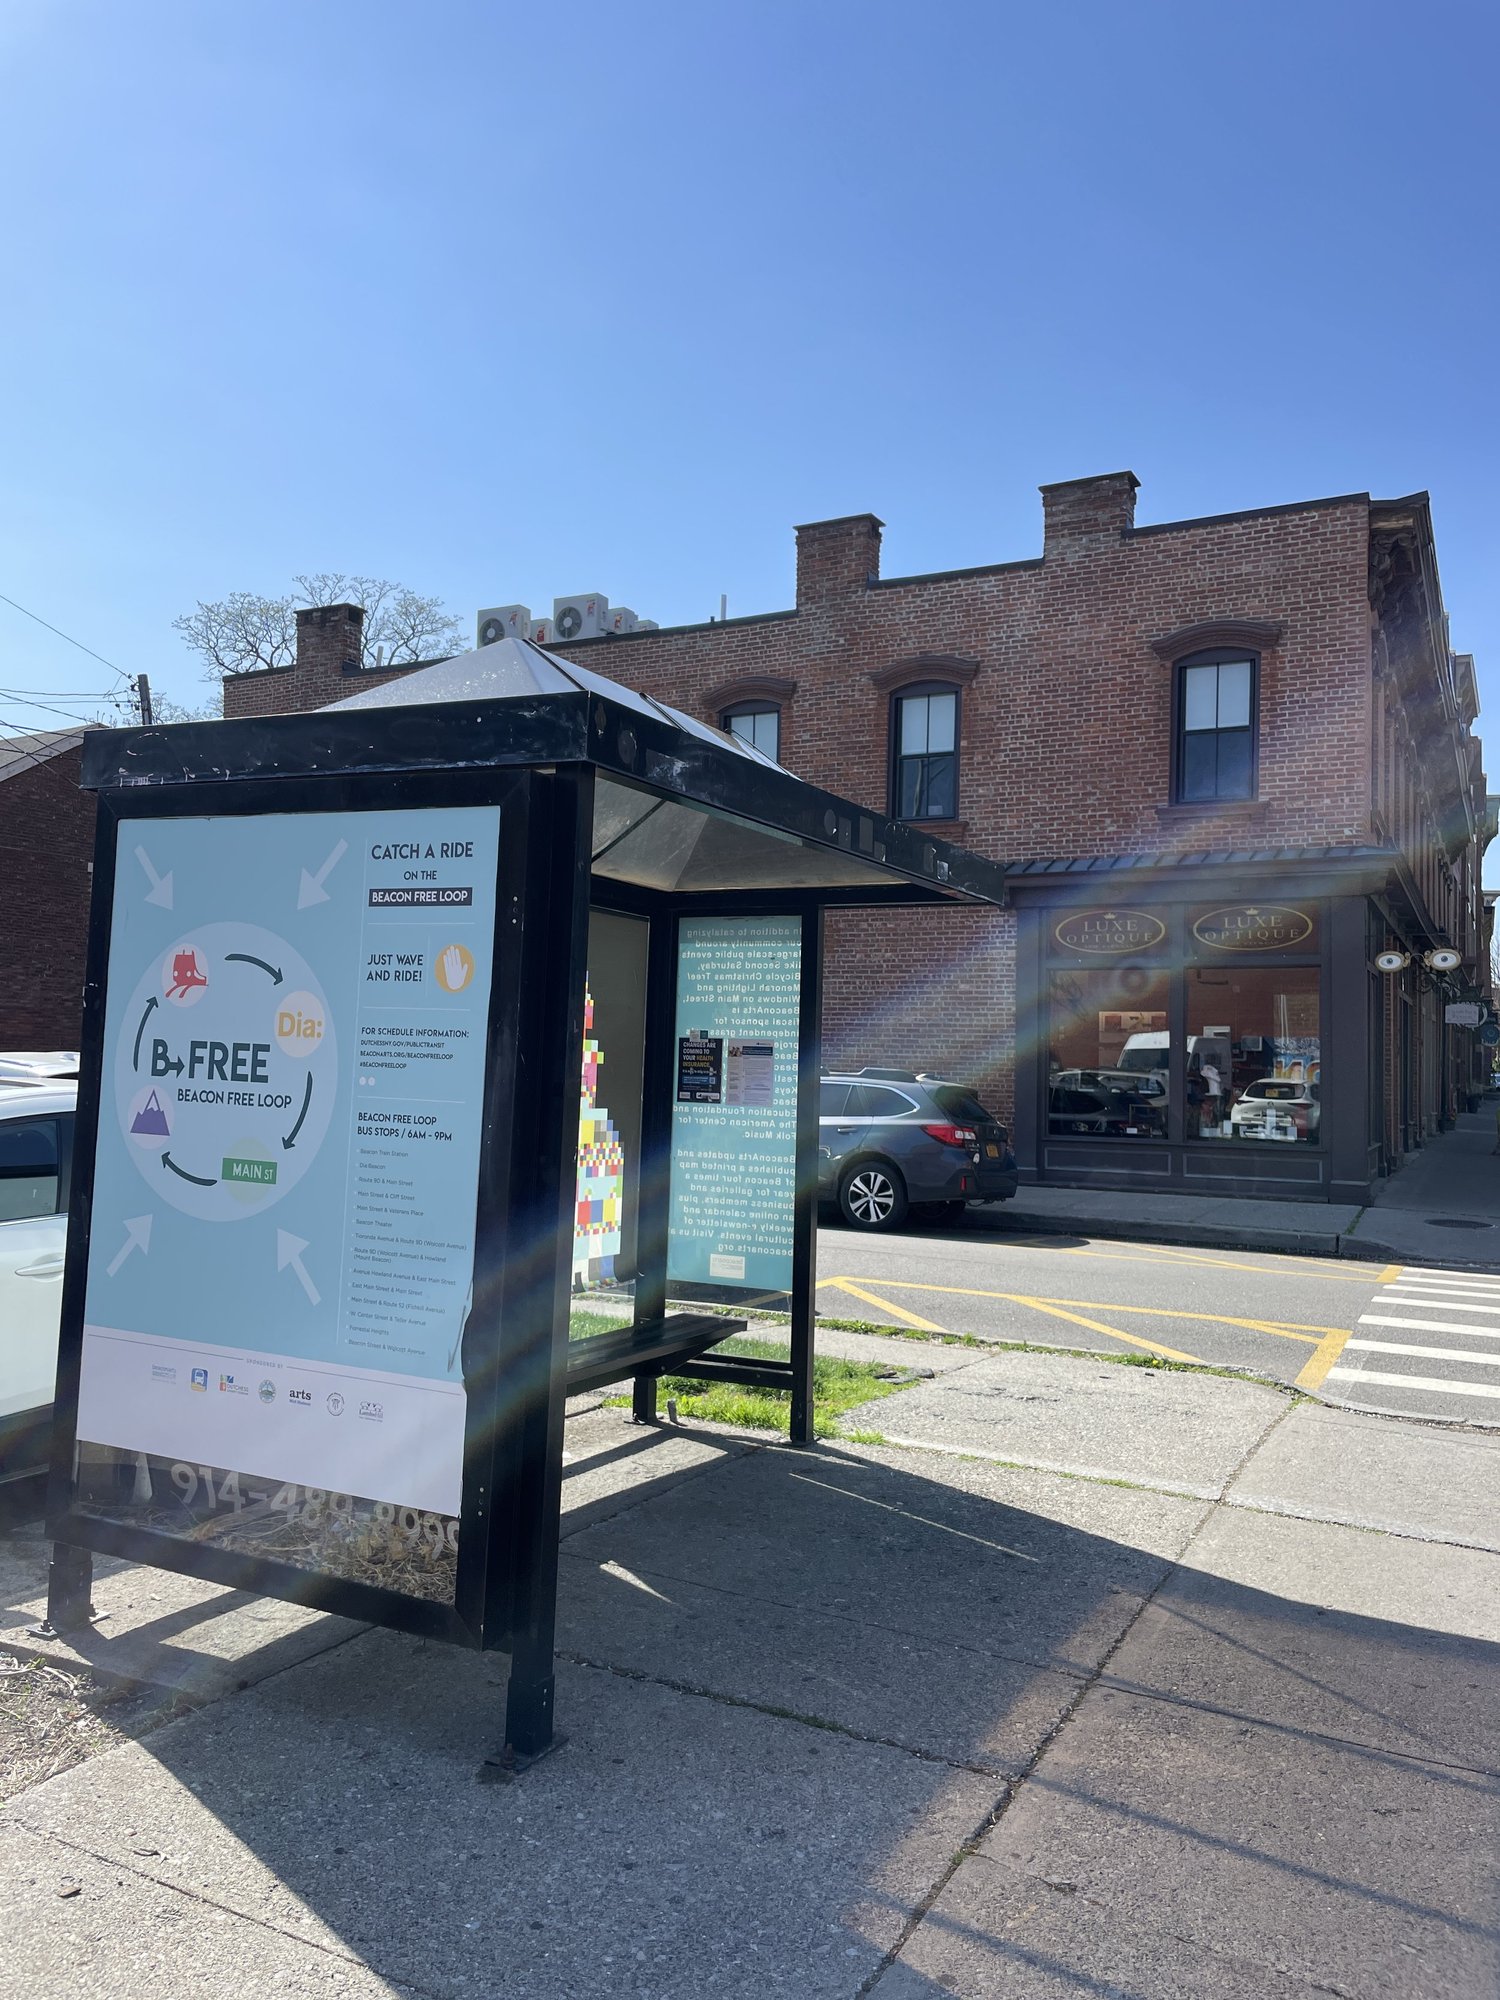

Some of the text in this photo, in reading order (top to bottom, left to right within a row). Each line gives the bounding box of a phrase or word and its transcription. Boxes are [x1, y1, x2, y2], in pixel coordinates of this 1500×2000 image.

[372, 842, 473, 859] CATCH A RIDE
[404, 870, 437, 880] ON THE
[372, 891, 468, 902] BEACON FREE LOOP
[1084, 920, 1138, 932] LUXE
[1224, 916, 1282, 929] LUXE
[1066, 933, 1153, 944] OPTIQUE
[1205, 929, 1300, 940] OPTIQUE
[368, 955, 423, 965] JUST WAVE
[367, 970, 422, 982] AND RIDE!
[278, 1012, 322, 1038] Dia:
[378, 1028, 413, 1036] SCHEDULE
[416, 1029, 469, 1038] INFORMATION:
[178, 1089, 292, 1108] BEACON FREE LOOP
[359, 1112, 436, 1125] BEACON FREE LOOP
[358, 1126, 372, 1135] BUS
[375, 1127, 399, 1137] STOPS
[408, 1130, 426, 1139] 6AM
[435, 1132, 452, 1140] 9PM
[232, 1163, 273, 1179] MAIN ST
[289, 1388, 311, 1401] arts
